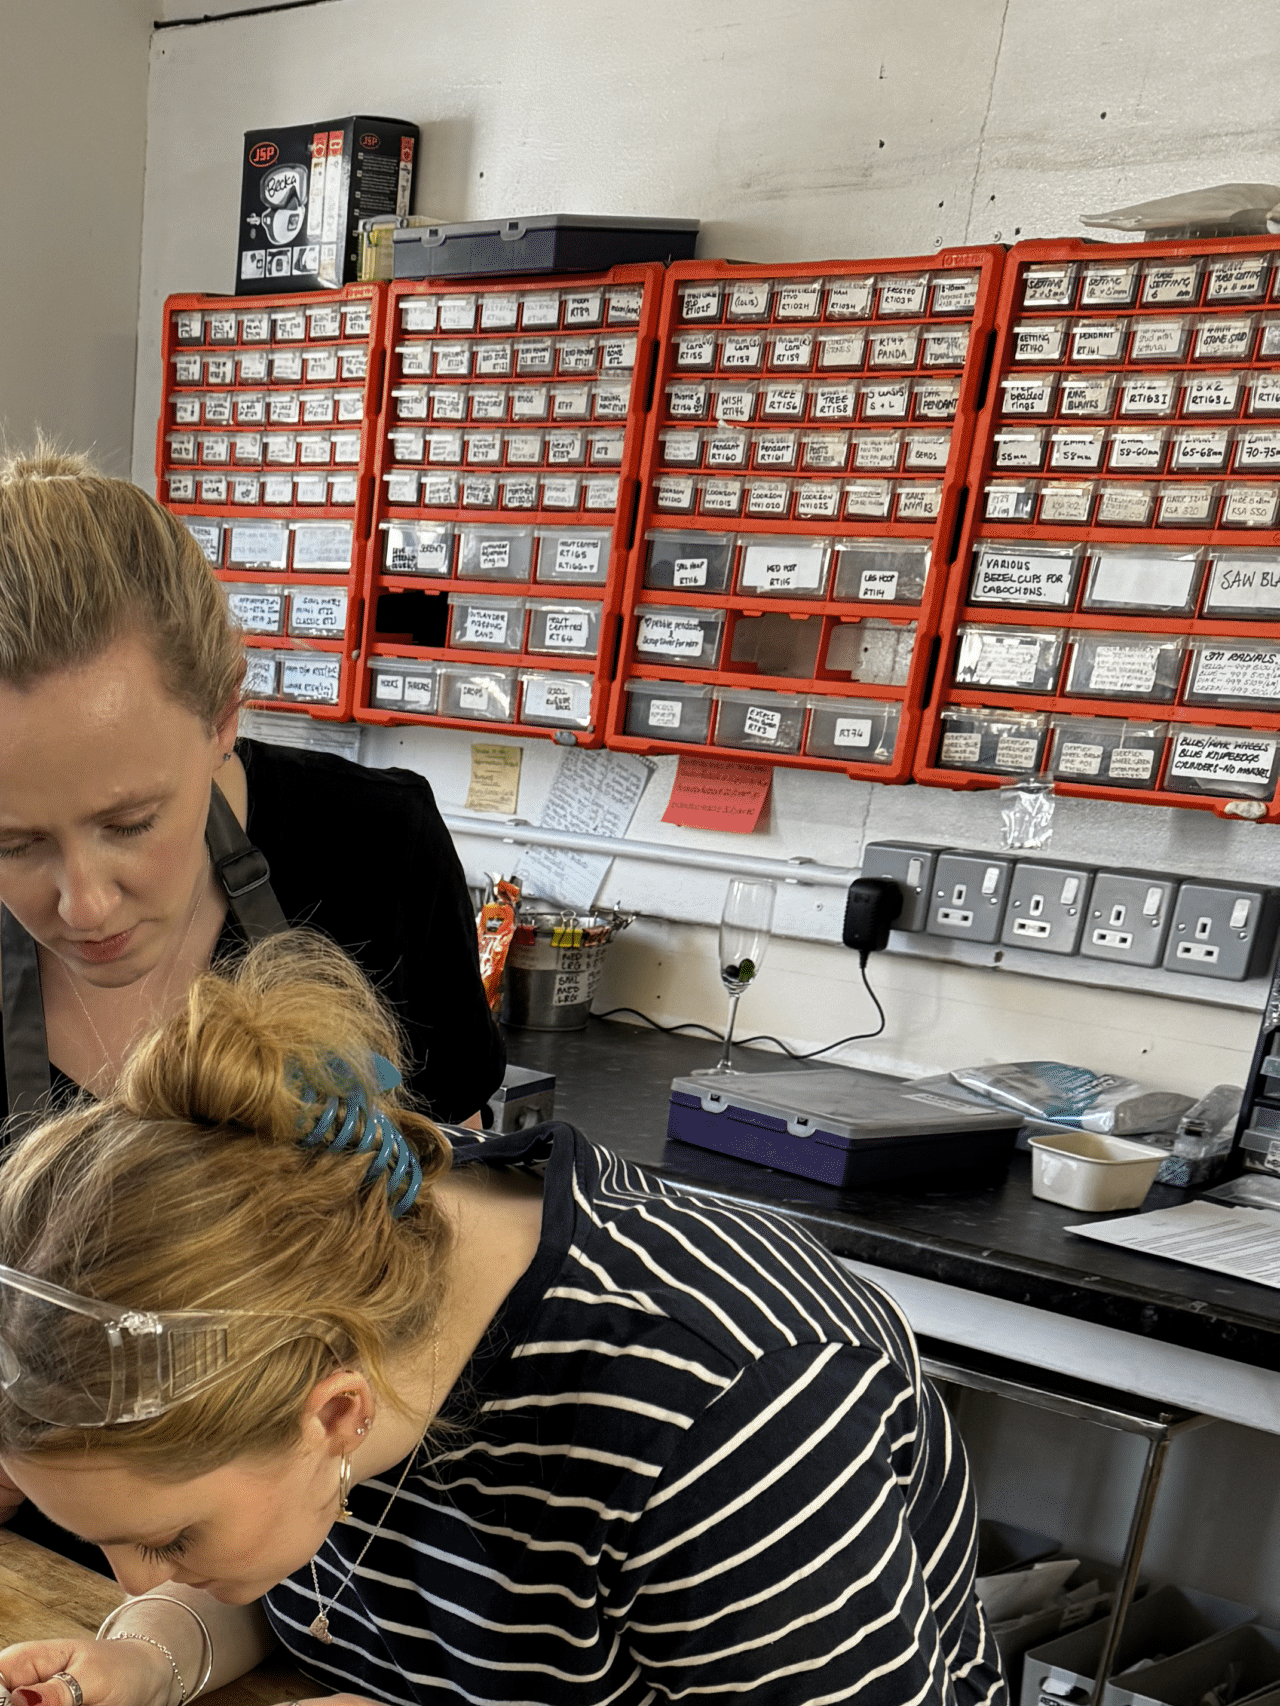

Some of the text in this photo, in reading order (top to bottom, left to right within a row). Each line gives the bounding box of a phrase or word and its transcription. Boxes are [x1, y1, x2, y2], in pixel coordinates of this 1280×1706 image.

[362, 136, 378, 146] JSP
[254, 147, 275, 162] JSP
[266, 175, 297, 198] Becka
[1150, 278, 1190, 289] SETTING
[571, 307, 590, 318] RT89
[877, 350, 907, 359] PANDA
[772, 390, 796, 399] TREE
[823, 395, 848, 404] TREE
[1010, 390, 1043, 401] beaded
[1259, 393, 1280, 402] RT16
[722, 396, 743, 405] WISH
[768, 401, 798, 410] RT156
[820, 404, 849, 414] RT158
[1011, 401, 1035, 411] rings
[711, 453, 737, 461] RT160
[760, 453, 784, 461] RT161
[1120, 448, 1159, 456] 58-60mm
[1182, 447, 1222, 457] 65-68mm
[986, 558, 1031, 571] VARIOUS
[983, 572, 1016, 584] BEZEL
[1046, 573, 1064, 584] FOR
[1221, 570, 1256, 590] SAW
[982, 585, 1047, 597] CABOCHONS.
[839, 729, 863, 738] RT74
[1178, 749, 1203, 758] BLUE
